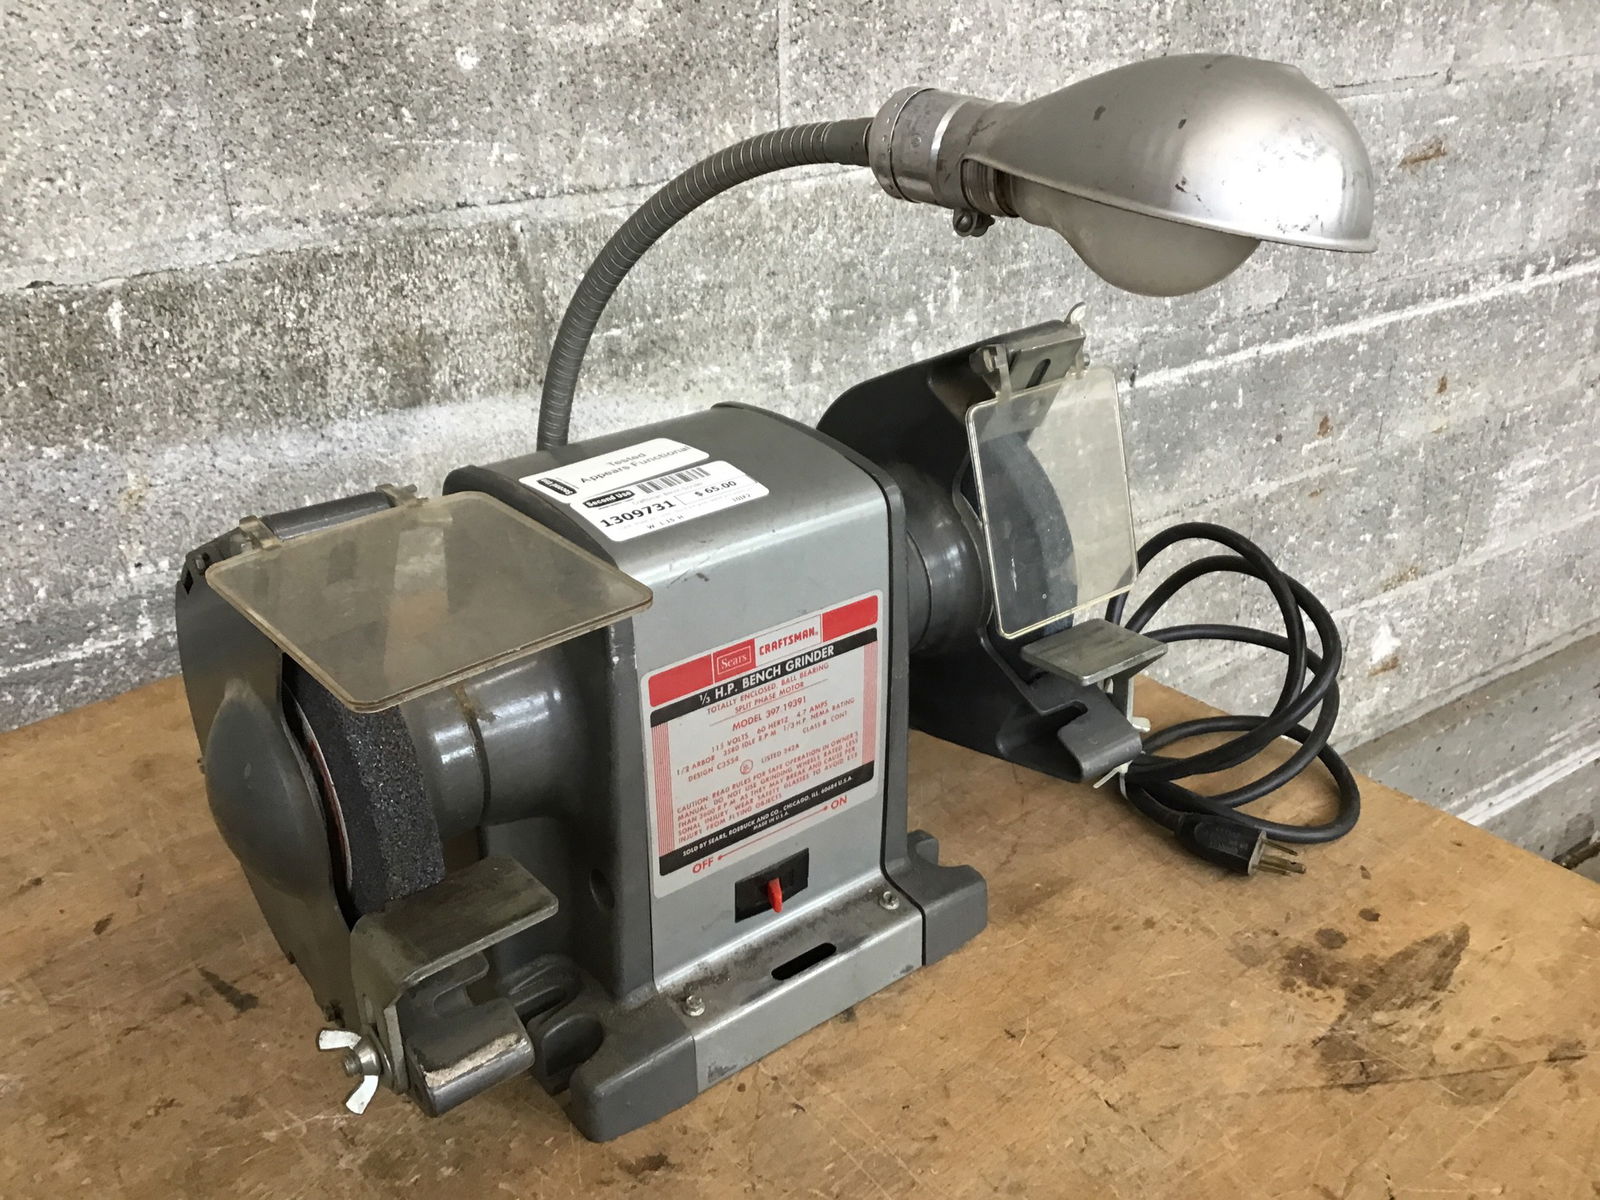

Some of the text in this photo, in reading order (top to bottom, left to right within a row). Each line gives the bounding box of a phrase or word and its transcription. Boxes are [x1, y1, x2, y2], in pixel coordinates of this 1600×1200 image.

[580, 446, 691, 483] Appears Functional
[608, 452, 646, 466] Tested
[585, 494, 616, 507] Second
[616, 491, 632, 500] Use
[601, 500, 676, 527] 1309731
[759, 627, 815, 656] CRAFTSMAN
[715, 681, 737, 699] H.P.
[742, 664, 780, 688] BENCH
[785, 644, 833, 672] GRINDER
[721, 653, 746, 669] Sears
[707, 698, 736, 714] TOTALLY
[781, 674, 795, 686] BALL
[799, 661, 828, 679] BEARING
[735, 680, 803, 714] SPLIT PHASE MOTOR
[691, 754, 714, 769] ARBOR
[741, 738, 754, 748] IDLE
[810, 707, 829, 720] NEMA
[832, 696, 854, 711] RATING
[711, 742, 723, 752] 115
[727, 732, 748, 746] VOLTS
[757, 725, 765, 734] 60
[768, 716, 787, 729] HERTZ
[809, 700, 827, 712] AMPS
[732, 712, 761, 731] MODEL
[802, 721, 820, 734] CLASS
[712, 786, 729, 798] READ
[732, 776, 750, 790] RULES
[753, 770, 764, 780] FOR
[768, 762, 782, 774] SAFE
[785, 746, 820, 766] OPERATION
[761, 750, 781, 763] LISTED
[688, 766, 713, 782] DESIGN
[713, 796, 723, 805] DO
[727, 788, 741, 799] NOT
[745, 781, 756, 791] USE
[760, 766, 792, 784] GRINDING
[796, 754, 819, 769] WHEELS
[824, 744, 842, 757] RATED
[678, 815, 696, 828] THAN
[740, 792, 748, 801] AS
[751, 784, 765, 796] THEY
[769, 776, 782, 788] MAY
[786, 767, 805, 780] BREAK
[808, 760, 821, 771] AND
[830, 796, 847, 810] ON
[678, 821, 700, 835] SONAL
[734, 797, 753, 810] WEAR
[678, 828, 702, 843] INJURY
[706, 817, 725, 830] FROM
[728, 805, 751, 820] FLYING
[753, 820, 767, 830] MADE
[682, 845, 698, 857] SOLD
[699, 841, 707, 849] BY
[729, 819, 754, 836] ROEBUCK
[756, 812, 769, 823] AND
[692, 858, 713, 874] OFF
